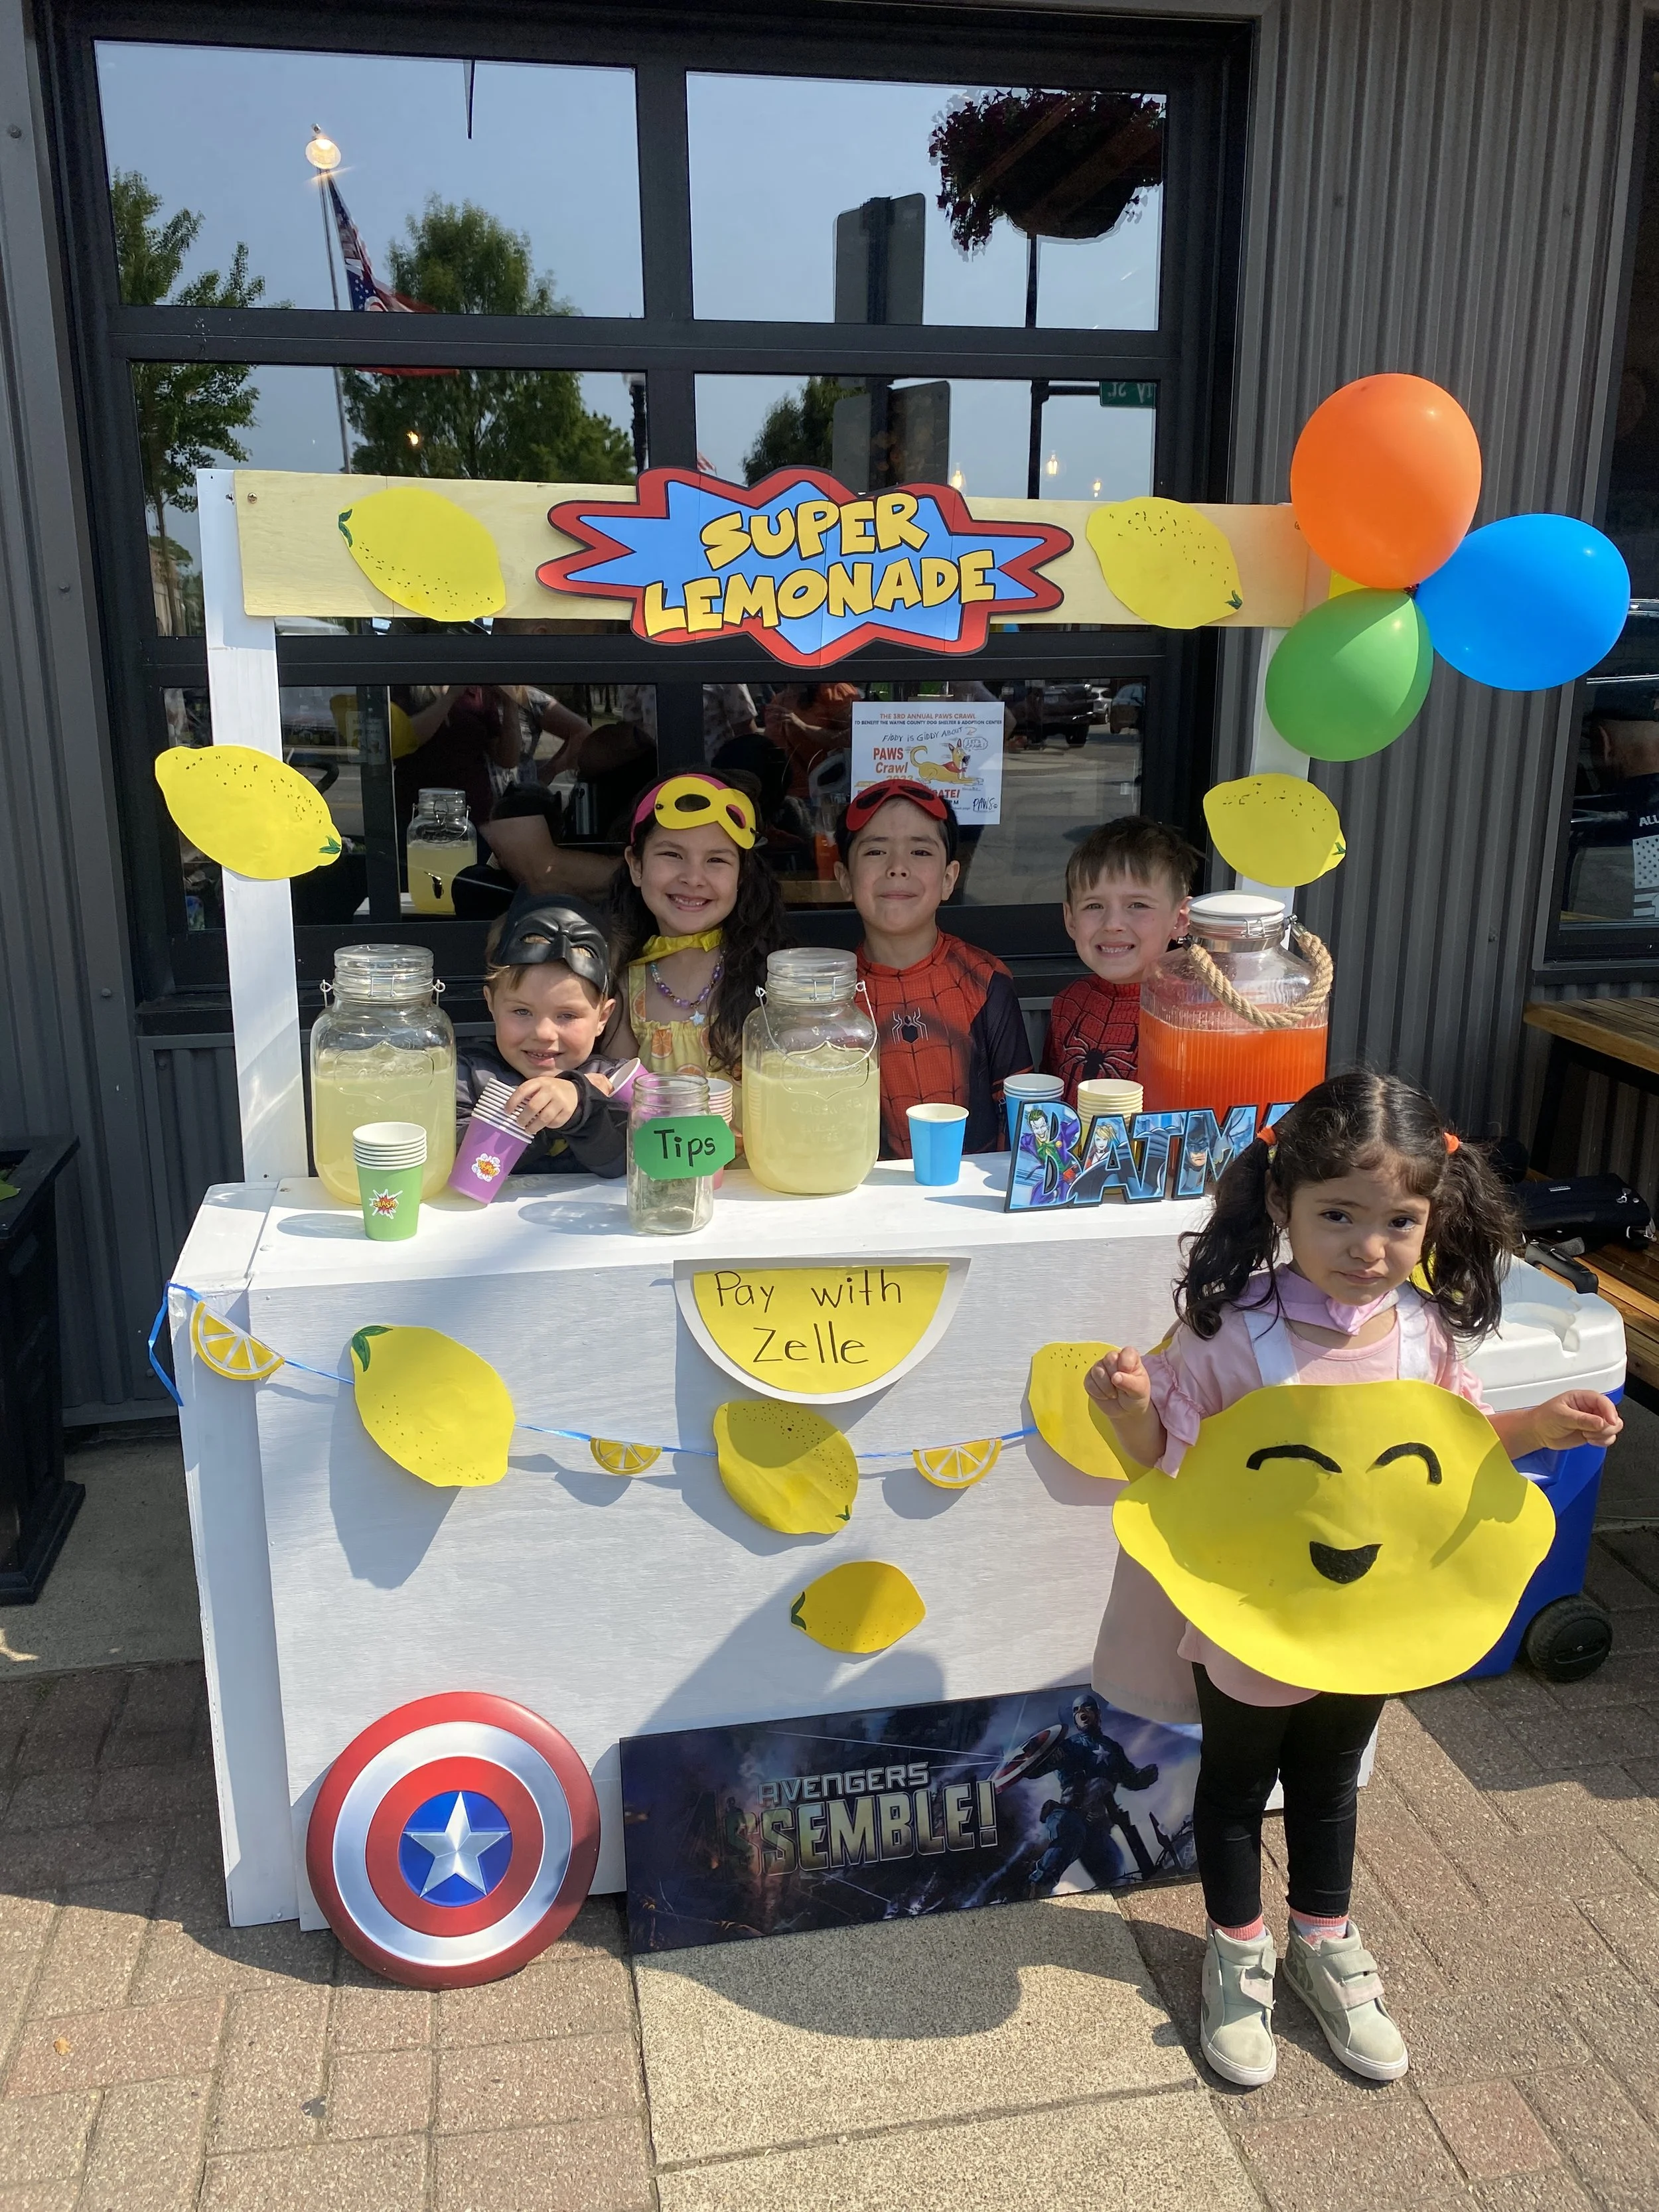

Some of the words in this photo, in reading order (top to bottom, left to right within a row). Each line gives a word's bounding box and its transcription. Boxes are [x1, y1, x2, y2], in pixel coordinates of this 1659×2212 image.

[701, 492, 929, 571] SUPER
[644, 550, 995, 637] LEMONADE
[941, 727, 962, 737] ABOUT
[873, 747, 904, 760] PAWS
[876, 762, 908, 774] Crawl
[973, 797, 995, 811] PAWS
[654, 1128, 716, 1167] Tips
[1005, 1100, 1295, 1212] BATM
[373, 1199, 398, 1209] CRASH!
[714, 1270, 774, 1313] Pay
[811, 1269, 902, 1308] with
[753, 1321, 869, 1364] Zelle
[757, 1761, 930, 1805] AVENGERS
